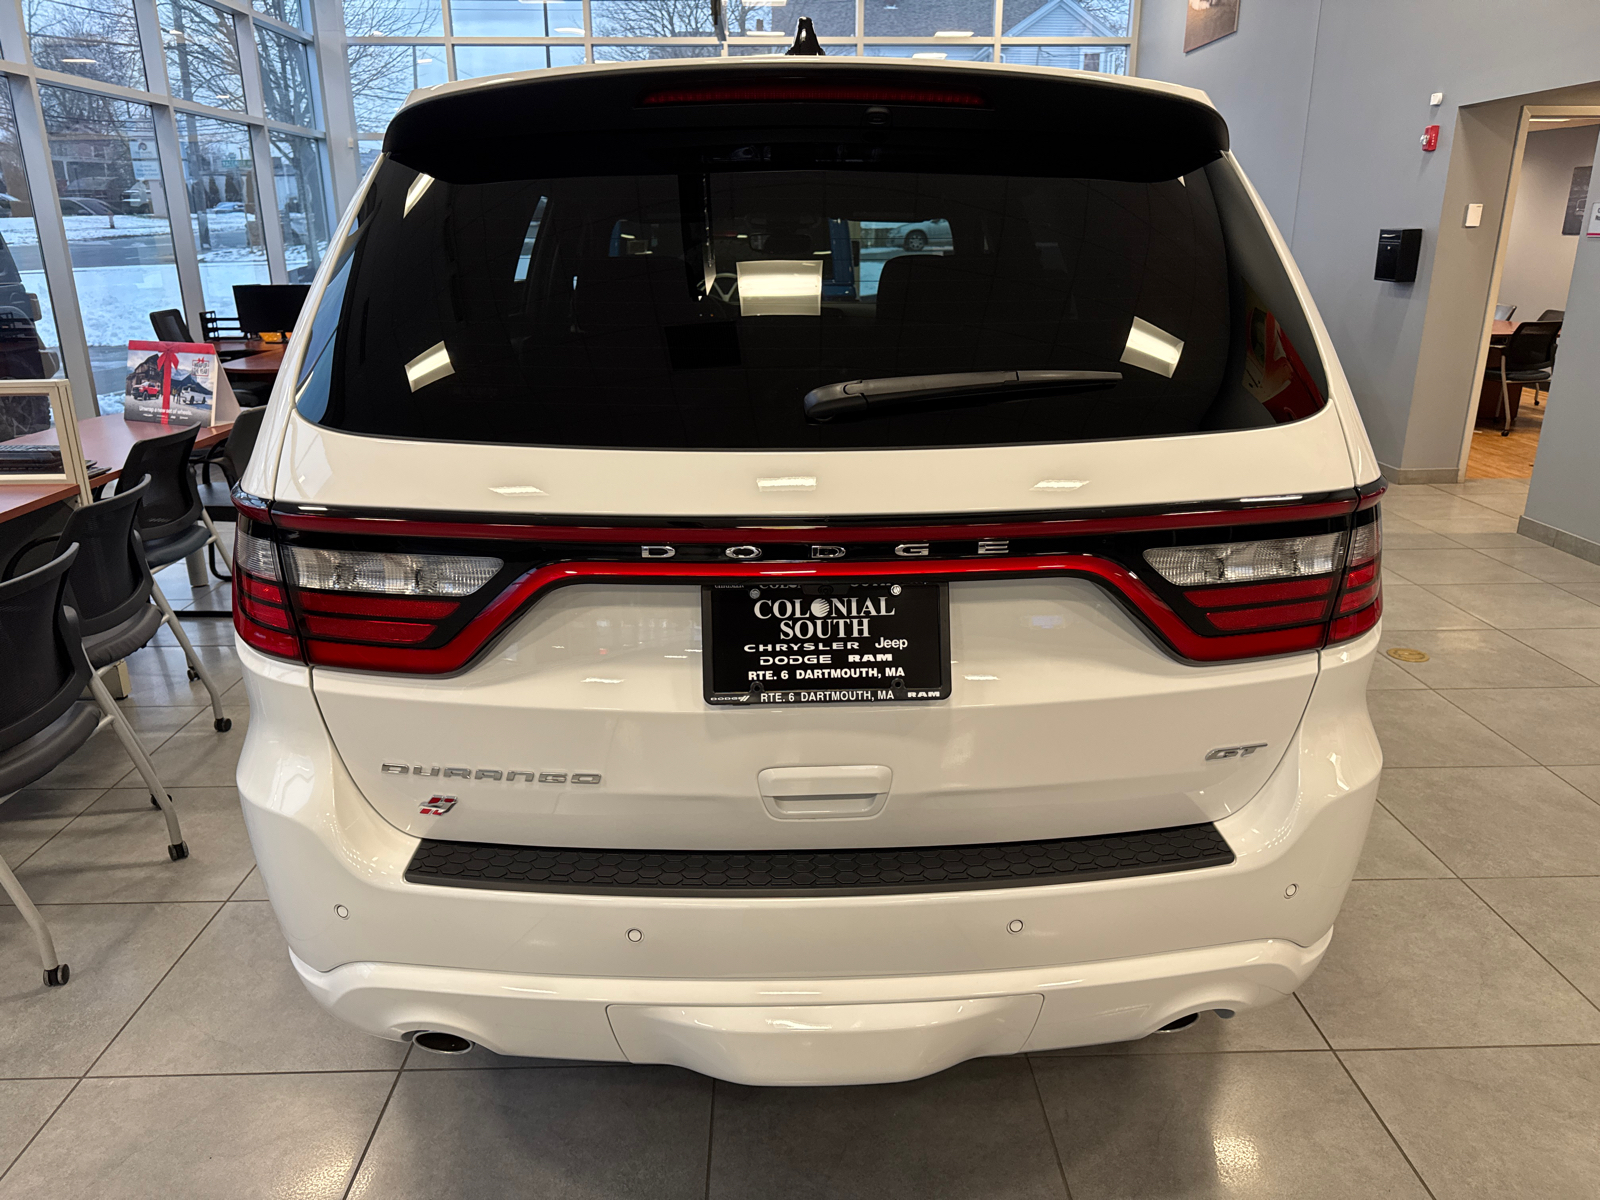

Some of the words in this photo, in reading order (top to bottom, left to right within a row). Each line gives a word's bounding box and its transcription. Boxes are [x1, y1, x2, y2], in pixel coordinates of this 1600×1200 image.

[641, 540, 1010, 559] DODGE
[754, 596, 896, 620] COLONIAL
[780, 617, 871, 640] SOUTH
[744, 641, 860, 652] CHRYSLER
[875, 637, 908, 650] Jeep
[760, 655, 832, 666] DODGE
[848, 653, 893, 663] RAM
[748, 670, 778, 681] RTE.
[781, 670, 789, 680] 6
[795, 668, 882, 680] DARTMOUTH,
[885, 667, 905, 677] MA
[760, 692, 785, 702] RTE.
[788, 692, 795, 702] 6
[800, 691, 875, 702] DARTMOUTH,
[877, 690, 895, 700] MA
[1204, 742, 1268, 761] GT
[381, 763, 602, 784] DURANGO
